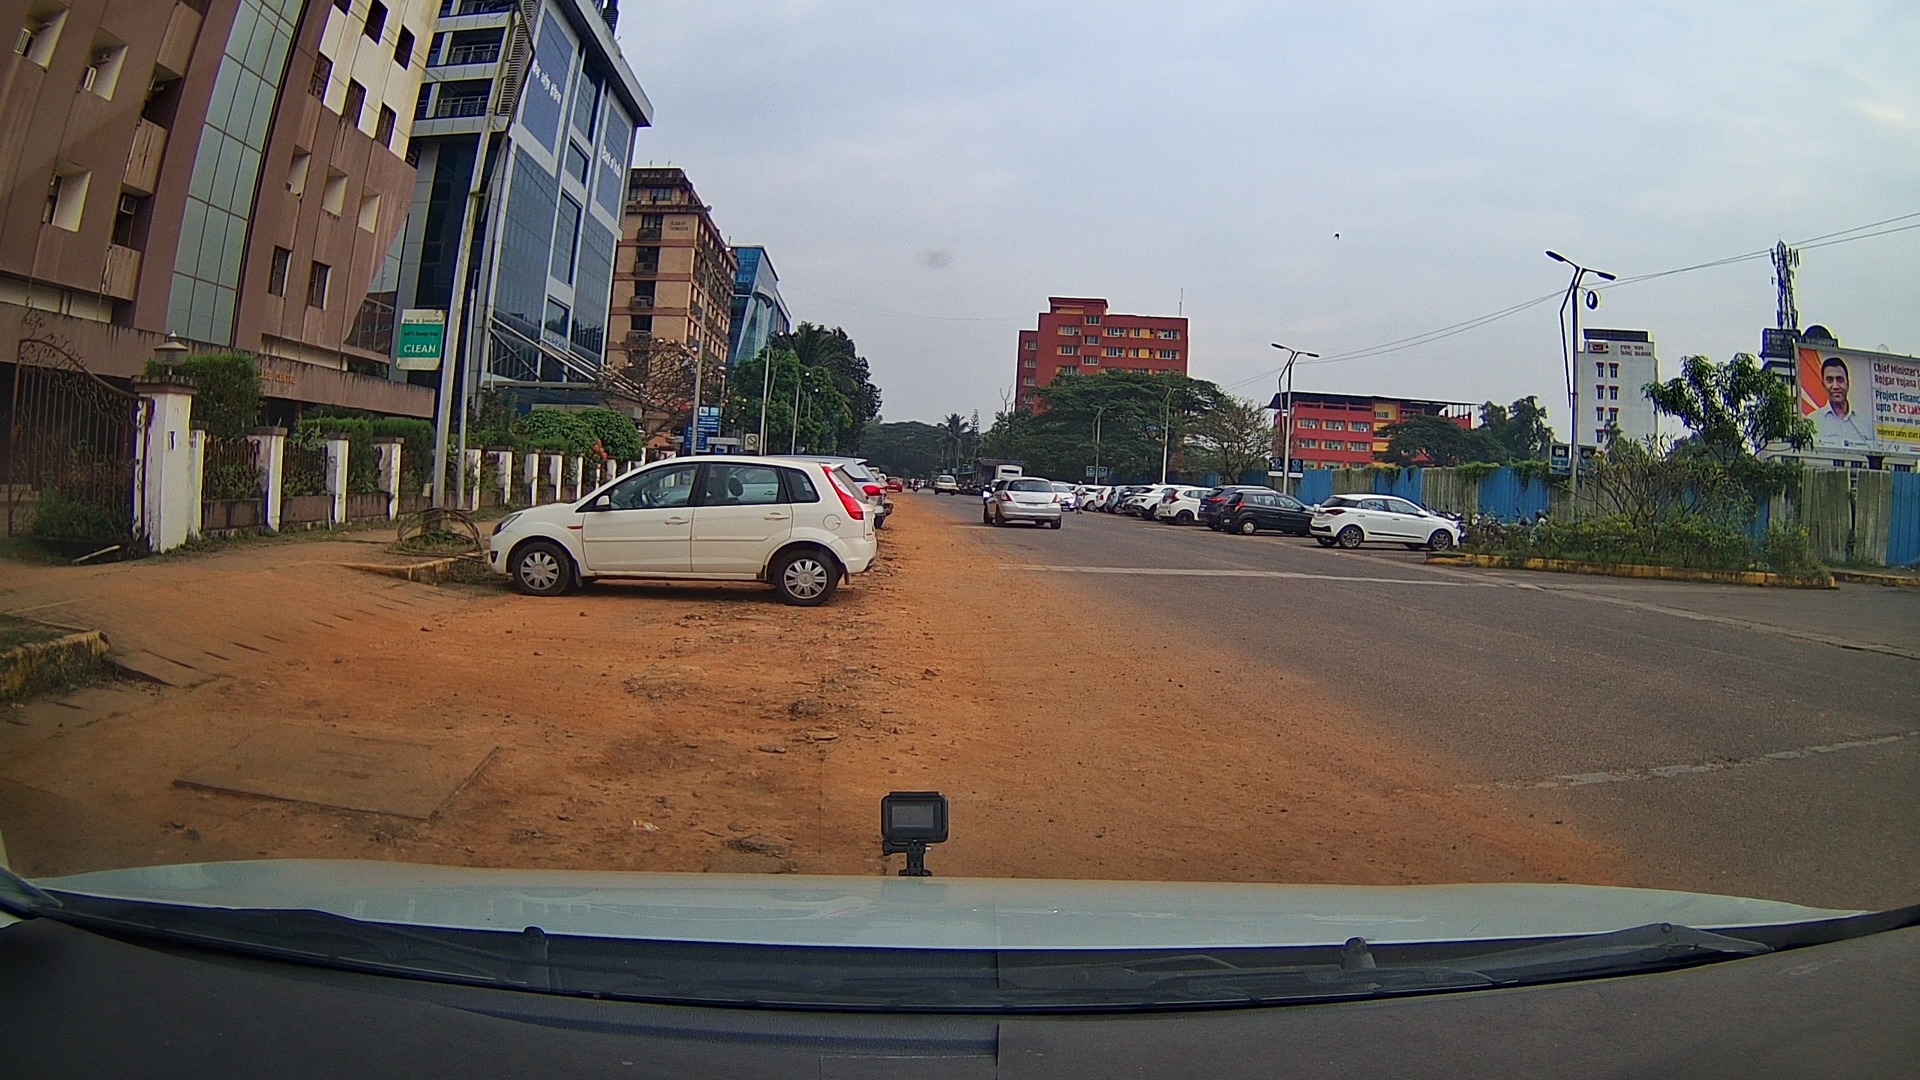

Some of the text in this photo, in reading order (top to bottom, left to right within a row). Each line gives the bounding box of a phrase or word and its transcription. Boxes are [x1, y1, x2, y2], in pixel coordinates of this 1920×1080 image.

[403, 344, 436, 353] CLEAN
[1874, 363, 1920, 378] Chief Minister's
[1875, 374, 1894, 386] Rojgar
[1896, 377, 1917, 388] Yojana
[1876, 389, 1898, 402] Project
[1876, 403, 1891, 413] upto
[1899, 404, 1906, 413] 25
